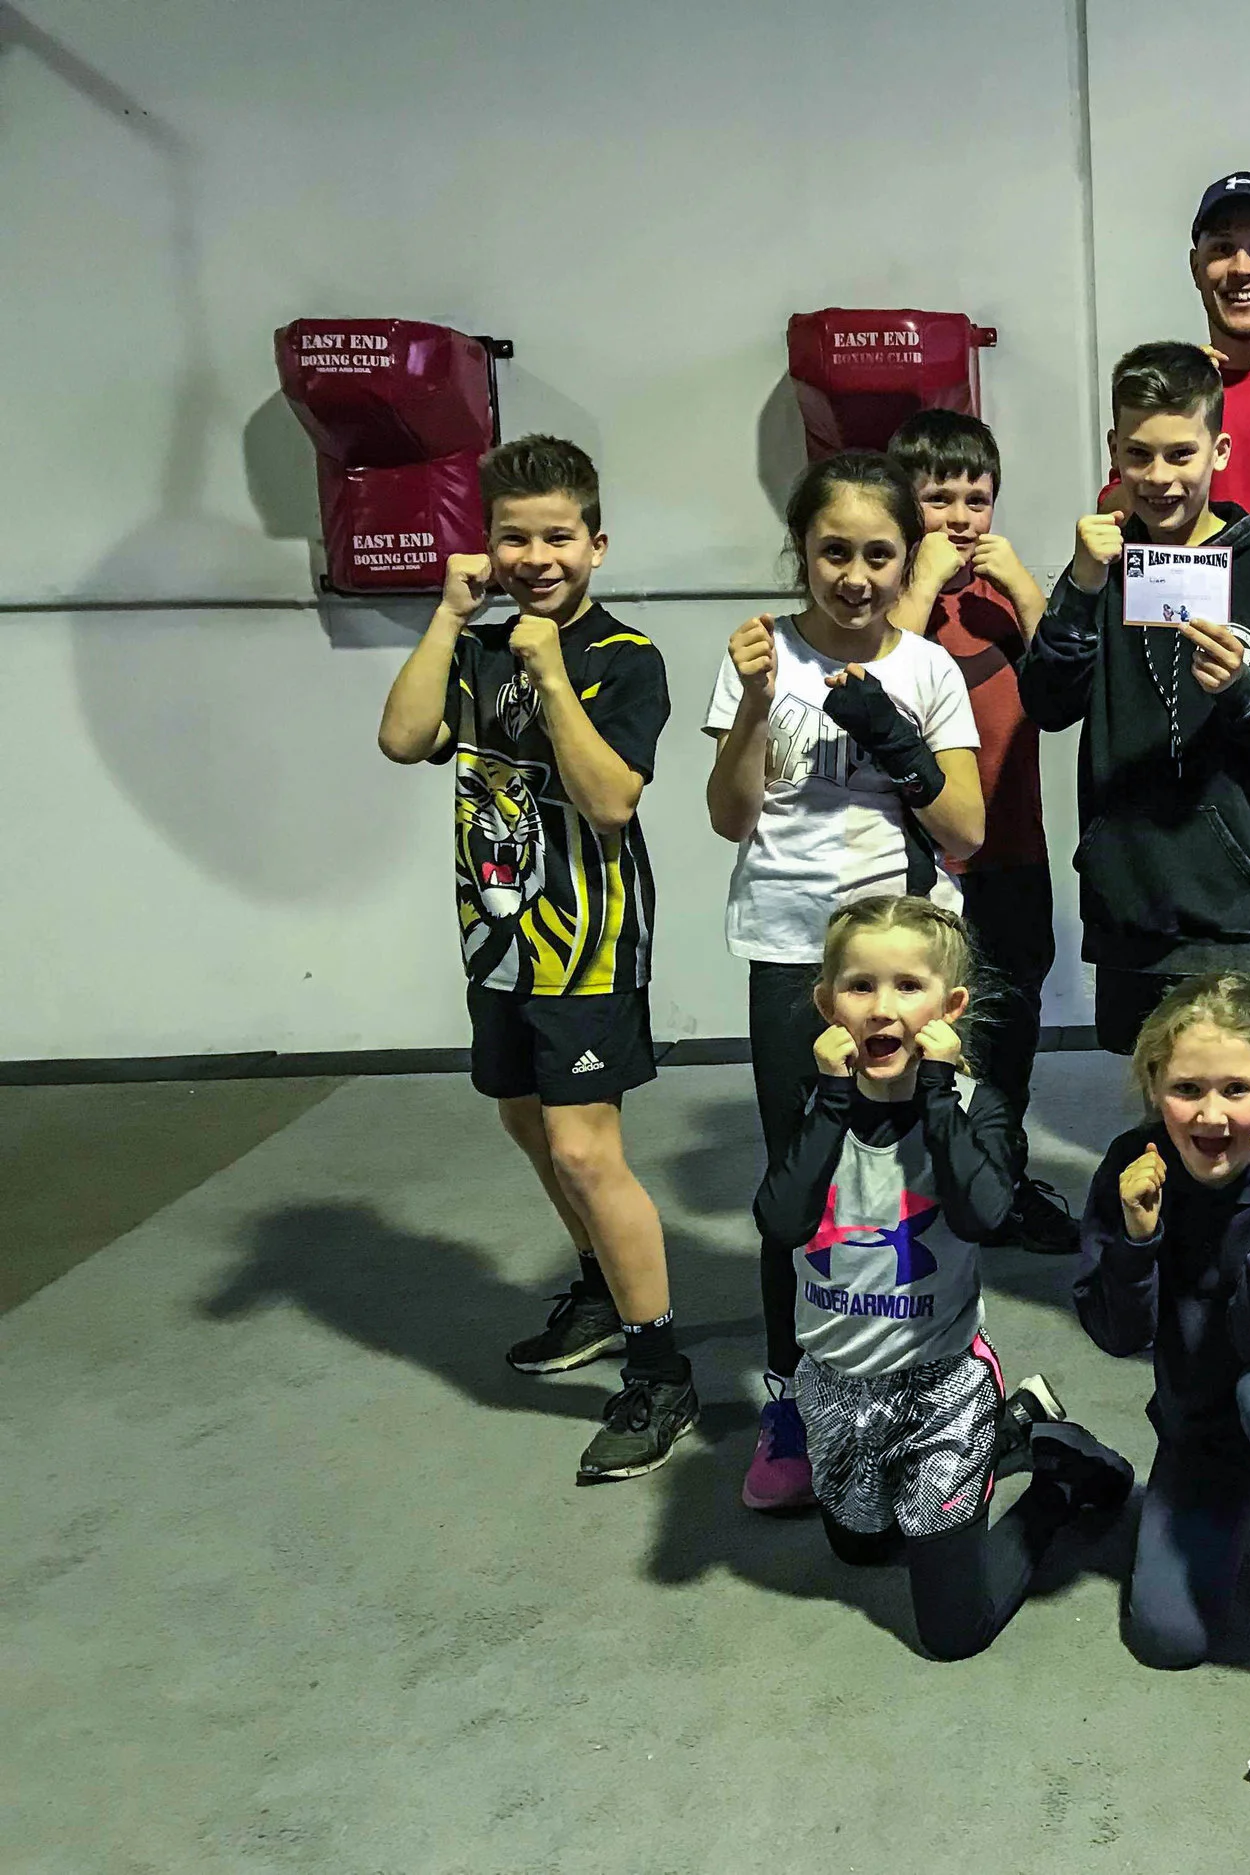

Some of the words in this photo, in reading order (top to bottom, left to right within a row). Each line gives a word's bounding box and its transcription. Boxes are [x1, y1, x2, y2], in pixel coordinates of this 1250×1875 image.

[301, 334, 346, 350] EAST
[350, 334, 389, 350] END
[833, 331, 879, 348] EAST
[883, 331, 920, 346] END
[300, 354, 350, 367] BOXING
[352, 354, 391, 368] CLUB
[832, 353, 884, 365] BOXING
[886, 351, 922, 364] CLUB
[352, 534, 395, 549] EAST
[399, 532, 435, 548] END
[353, 553, 401, 566] BOXING
[403, 552, 438, 564] CLUB
[1148, 549, 1172, 566] EAST
[1173, 554, 1192, 564] END
[1193, 552, 1228, 569] BOXING
[571, 1061, 605, 1074] adidas
[804, 1281, 849, 1316] UNDER
[849, 1293, 935, 1320] ARMOUR
